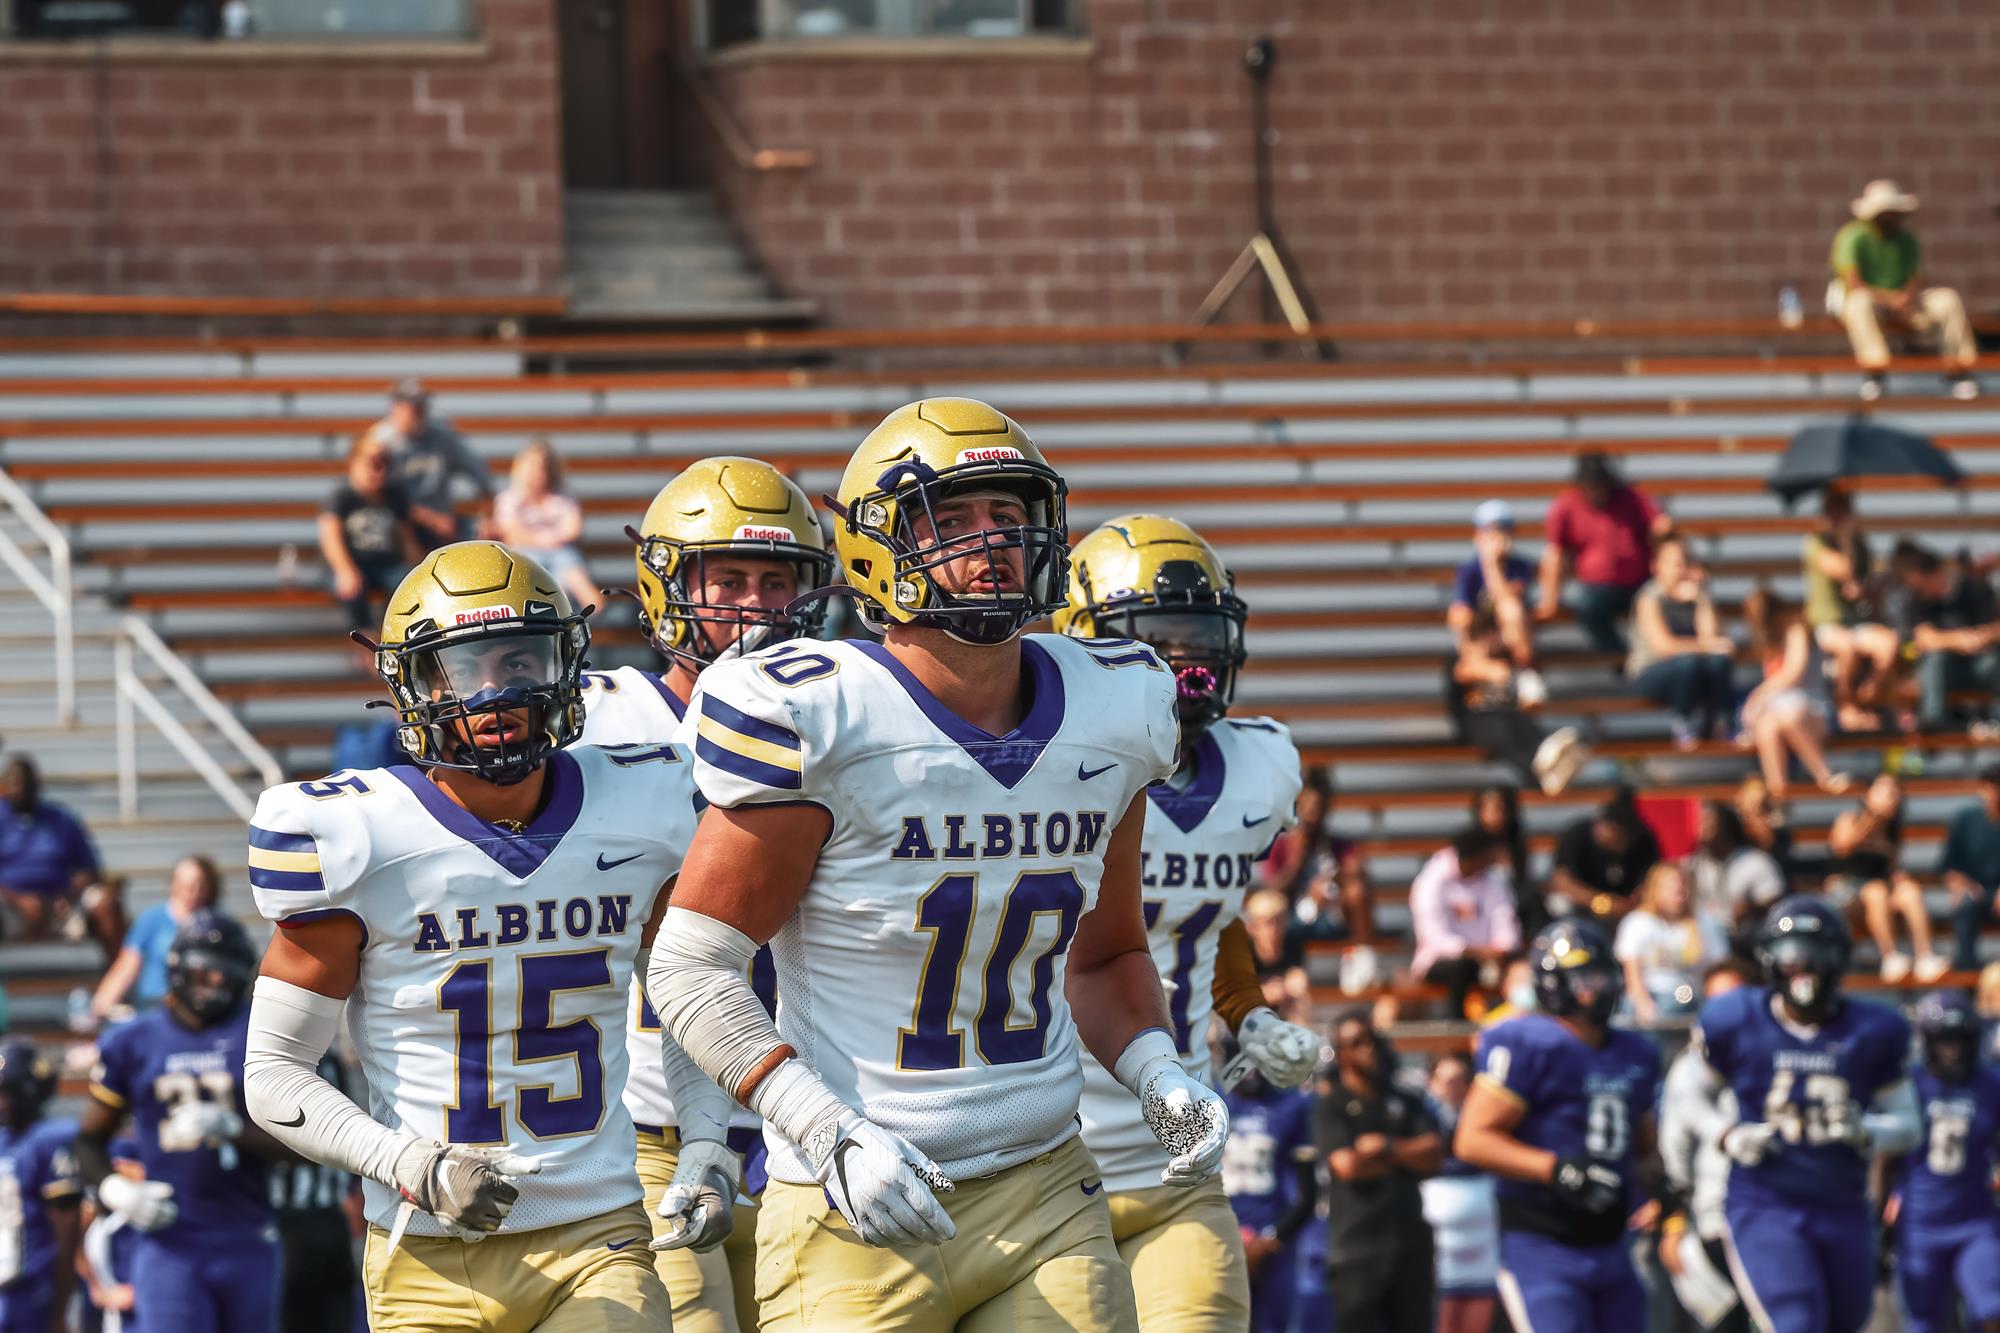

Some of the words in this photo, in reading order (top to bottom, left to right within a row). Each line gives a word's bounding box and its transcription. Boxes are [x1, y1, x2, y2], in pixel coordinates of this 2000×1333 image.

[743, 527, 791, 541] Riddell
[455, 607, 511, 625] Riddell
[295, 769, 376, 801] 5
[891, 810, 1108, 861] ALBION
[1141, 851, 1255, 888] LBION
[413, 894, 632, 954] ALBION
[895, 867, 1087, 1072] 10
[435, 946, 614, 1147] 15
